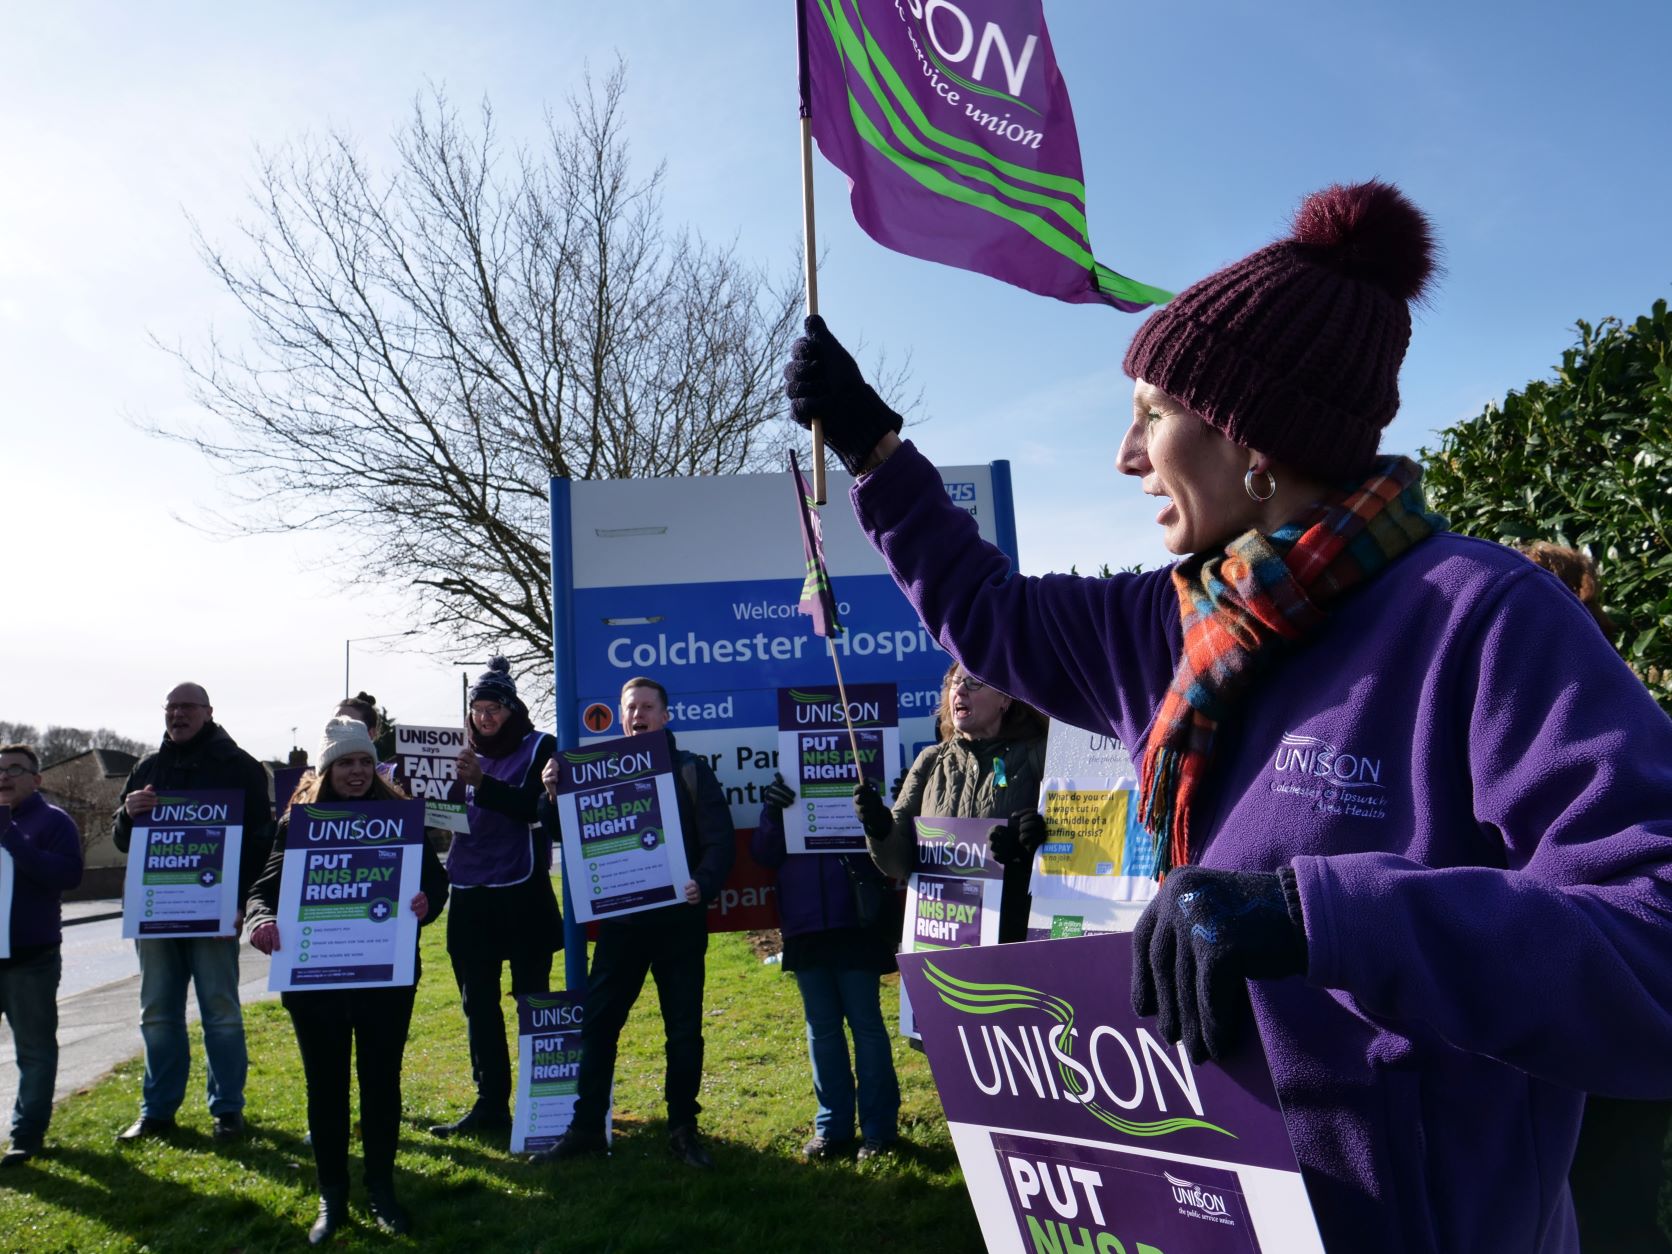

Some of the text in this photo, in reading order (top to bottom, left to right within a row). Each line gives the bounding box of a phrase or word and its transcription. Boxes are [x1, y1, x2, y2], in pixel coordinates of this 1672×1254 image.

[965, 103, 1044, 149] union
[607, 632, 808, 668] Colchester
[795, 702, 879, 724] UNISON
[399, 729, 465, 746] UNISON
[802, 736, 839, 751] PUT
[1090, 735, 1126, 751] UNI
[422, 746, 440, 754] says
[736, 746, 779, 770] Par
[803, 749, 878, 765] NHS PAY
[404, 756, 458, 780] FAIR
[572, 751, 652, 785] UNISON
[803, 763, 859, 780] RIGHT
[1275, 748, 1381, 783] UNISON
[410, 778, 454, 800] PAY
[1070, 793, 1081, 801] do
[1084, 794, 1098, 803] you
[579, 791, 615, 811] PUT
[1053, 807, 1074, 815] wage
[1091, 805, 1099, 813] in
[151, 804, 228, 822] UNISON
[581, 797, 653, 824] NHS PAY
[1345, 804, 1386, 819] Health
[308, 818, 404, 841] UNISON
[583, 815, 637, 840] RIGHT
[1060, 816, 1089, 825] middle
[1091, 816, 1100, 825] of
[150, 831, 186, 844] PUT
[1077, 828, 1104, 837] crisis?
[149, 843, 219, 856] NHS PAY
[919, 841, 987, 868] UNISON
[148, 855, 201, 869] RIGHT
[310, 854, 352, 870] PUT
[308, 867, 395, 885] NHS PAY
[306, 882, 372, 901] RIGHT
[919, 882, 944, 901] PUT
[918, 900, 977, 924] NHS PAY
[917, 918, 960, 941] RIGHT
[532, 1005, 584, 1027] UNISO
[534, 1038, 564, 1053] PUT
[534, 1051, 566, 1066] NHS
[534, 1063, 580, 1079] RIGHT
[957, 1024, 1205, 1117] UNISON
[1008, 1156, 1107, 1227] PUT
[1172, 1185, 1226, 1213] UNISON
[1178, 1206, 1186, 1215] the
[1187, 1209, 1201, 1219] public
